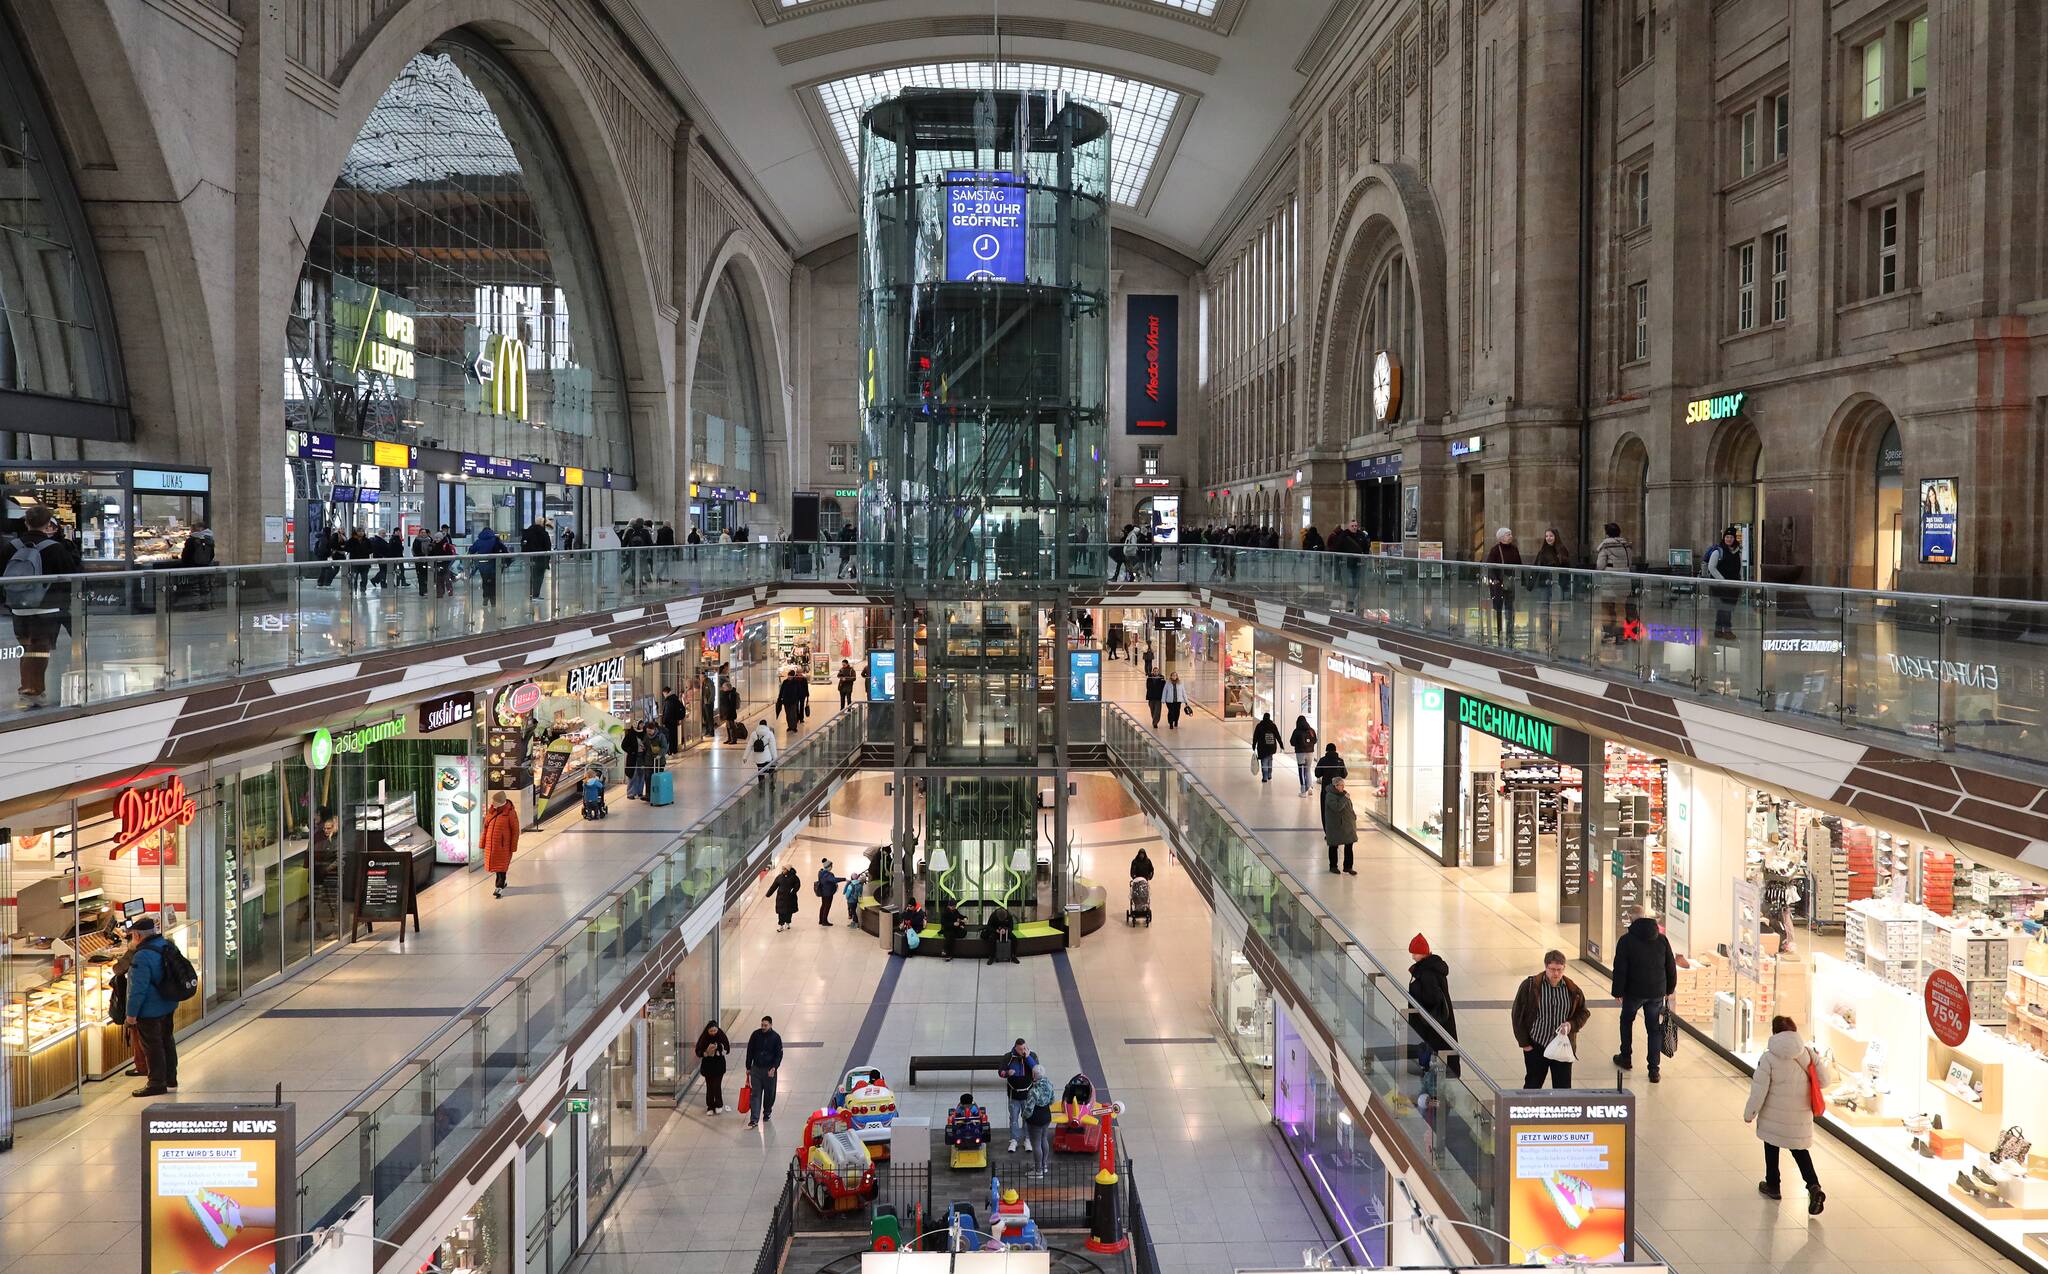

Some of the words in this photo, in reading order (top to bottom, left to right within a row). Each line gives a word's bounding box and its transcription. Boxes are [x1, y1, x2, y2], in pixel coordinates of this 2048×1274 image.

[953, 190, 1004, 201] SAMSTAG
[994, 204, 1020, 214] UHR
[952, 214, 1018, 228] GEÖFFNET.
[386, 309, 415, 345] OPER
[372, 341, 415, 380] LEIPZIG
[1686, 392, 1744, 425] SUBWAY
[288, 434, 297, 453] S
[300, 432, 308, 447] 18
[410, 447, 418, 460] 19
[46, 472, 80, 484] LUKAS
[162, 474, 183, 488] LUKAS
[1460, 696, 1552, 754] DEICHMANN
[335, 715, 406, 754] asiagourmet
[119, 775, 184, 844] Ditsch
[1932, 1000, 1962, 1030] 75%
[1586, 1106, 1628, 1118] NEWS
[232, 1120, 277, 1133] NEWS
